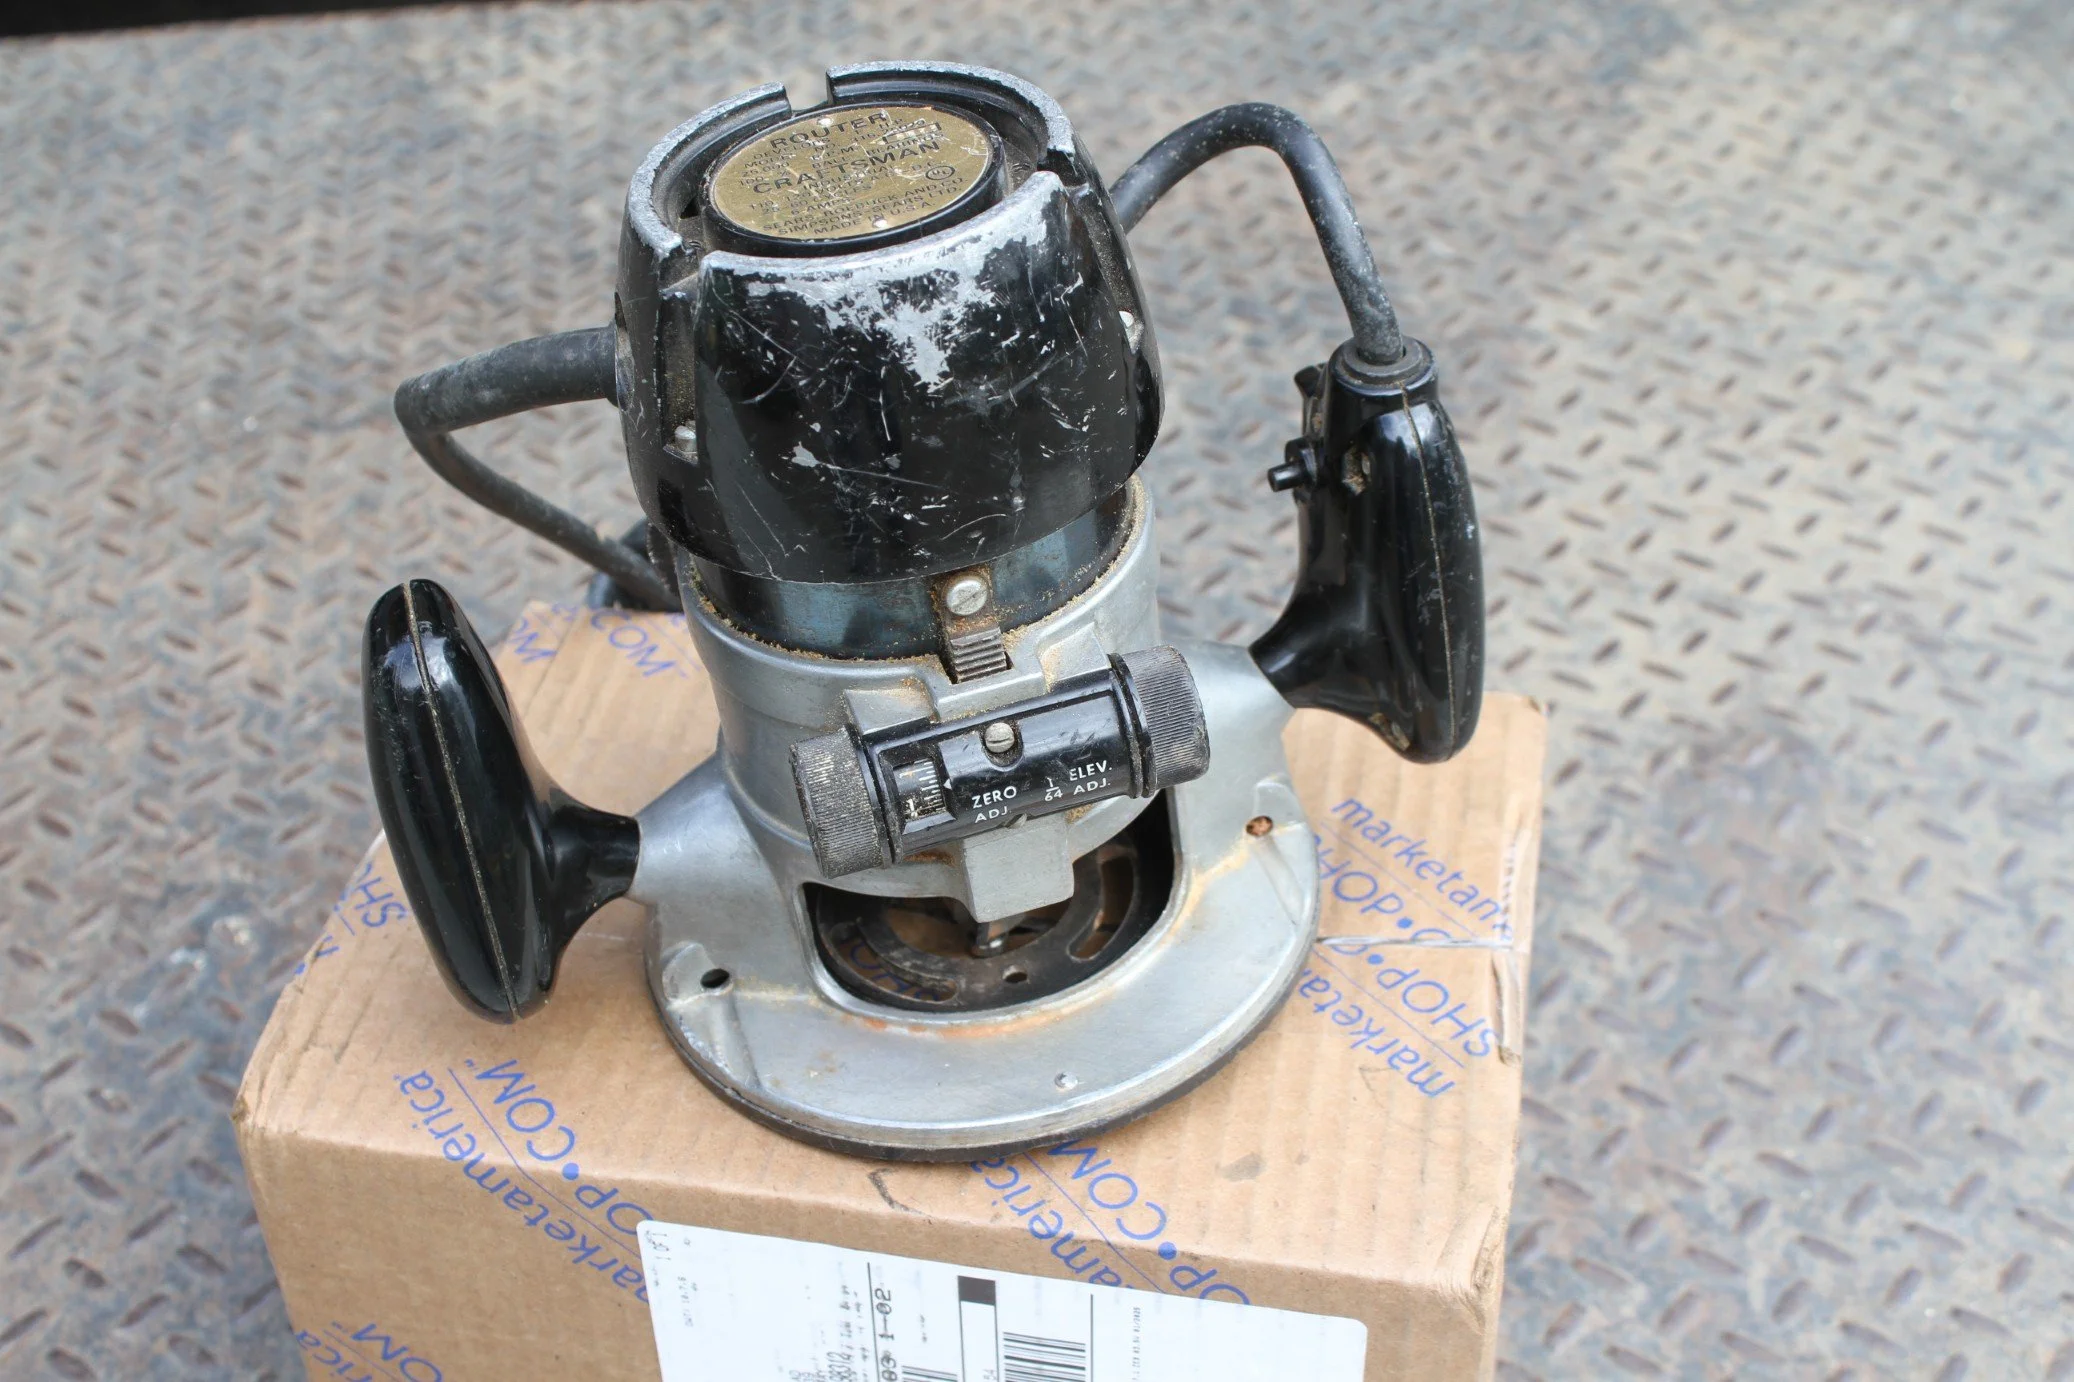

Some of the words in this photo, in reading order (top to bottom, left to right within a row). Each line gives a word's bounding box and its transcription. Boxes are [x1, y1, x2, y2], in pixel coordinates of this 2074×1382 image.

[770, 112, 887, 149] ROUTER
[753, 141, 940, 193] CRAFTSMAN
[813, 219, 862, 235] MADE
[1069, 760, 1113, 782] ELEV.
[971, 785, 1018, 809] ZERO
[1073, 777, 1111, 796] ADJ.
[1298, 968, 1456, 1098] marketa
